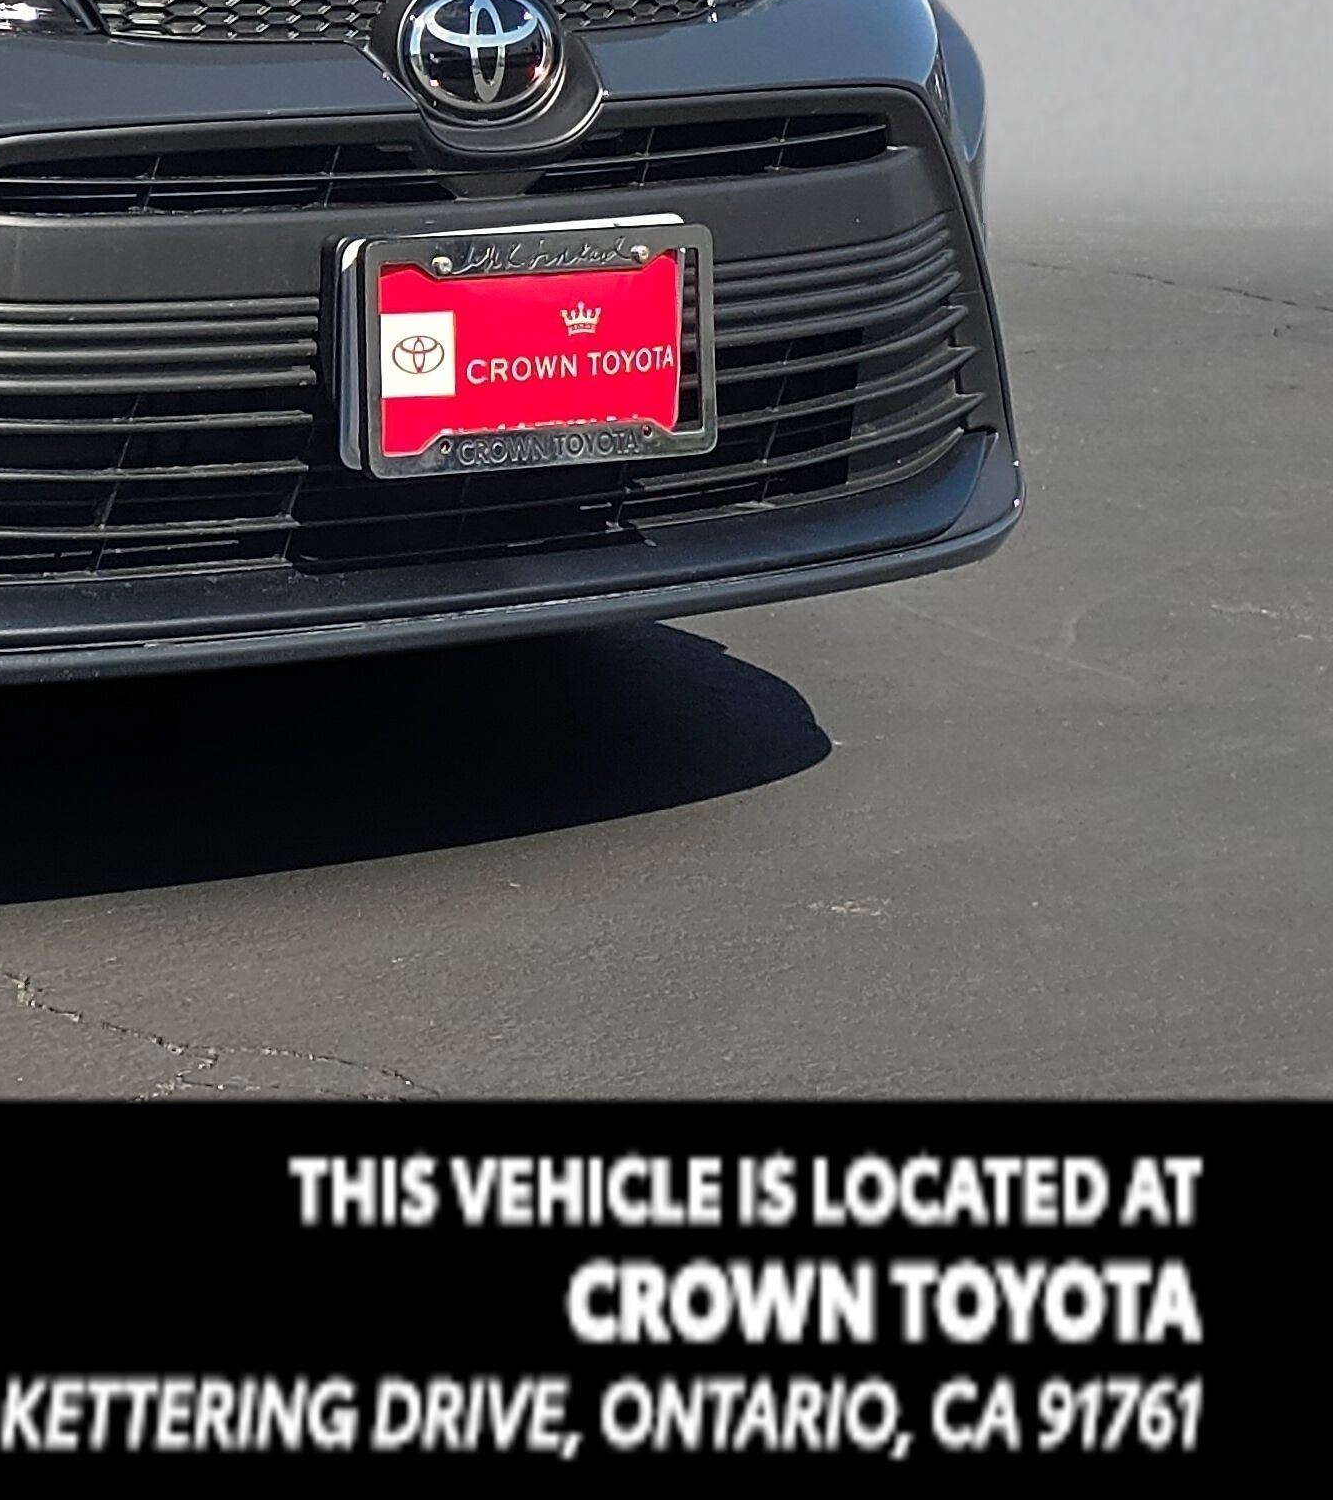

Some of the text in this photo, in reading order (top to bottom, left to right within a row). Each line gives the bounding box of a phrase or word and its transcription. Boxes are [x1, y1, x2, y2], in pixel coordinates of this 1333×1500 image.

[465, 344, 675, 385] CROWN TOYOTA
[457, 430, 640, 466] CROWN TOYOTA
